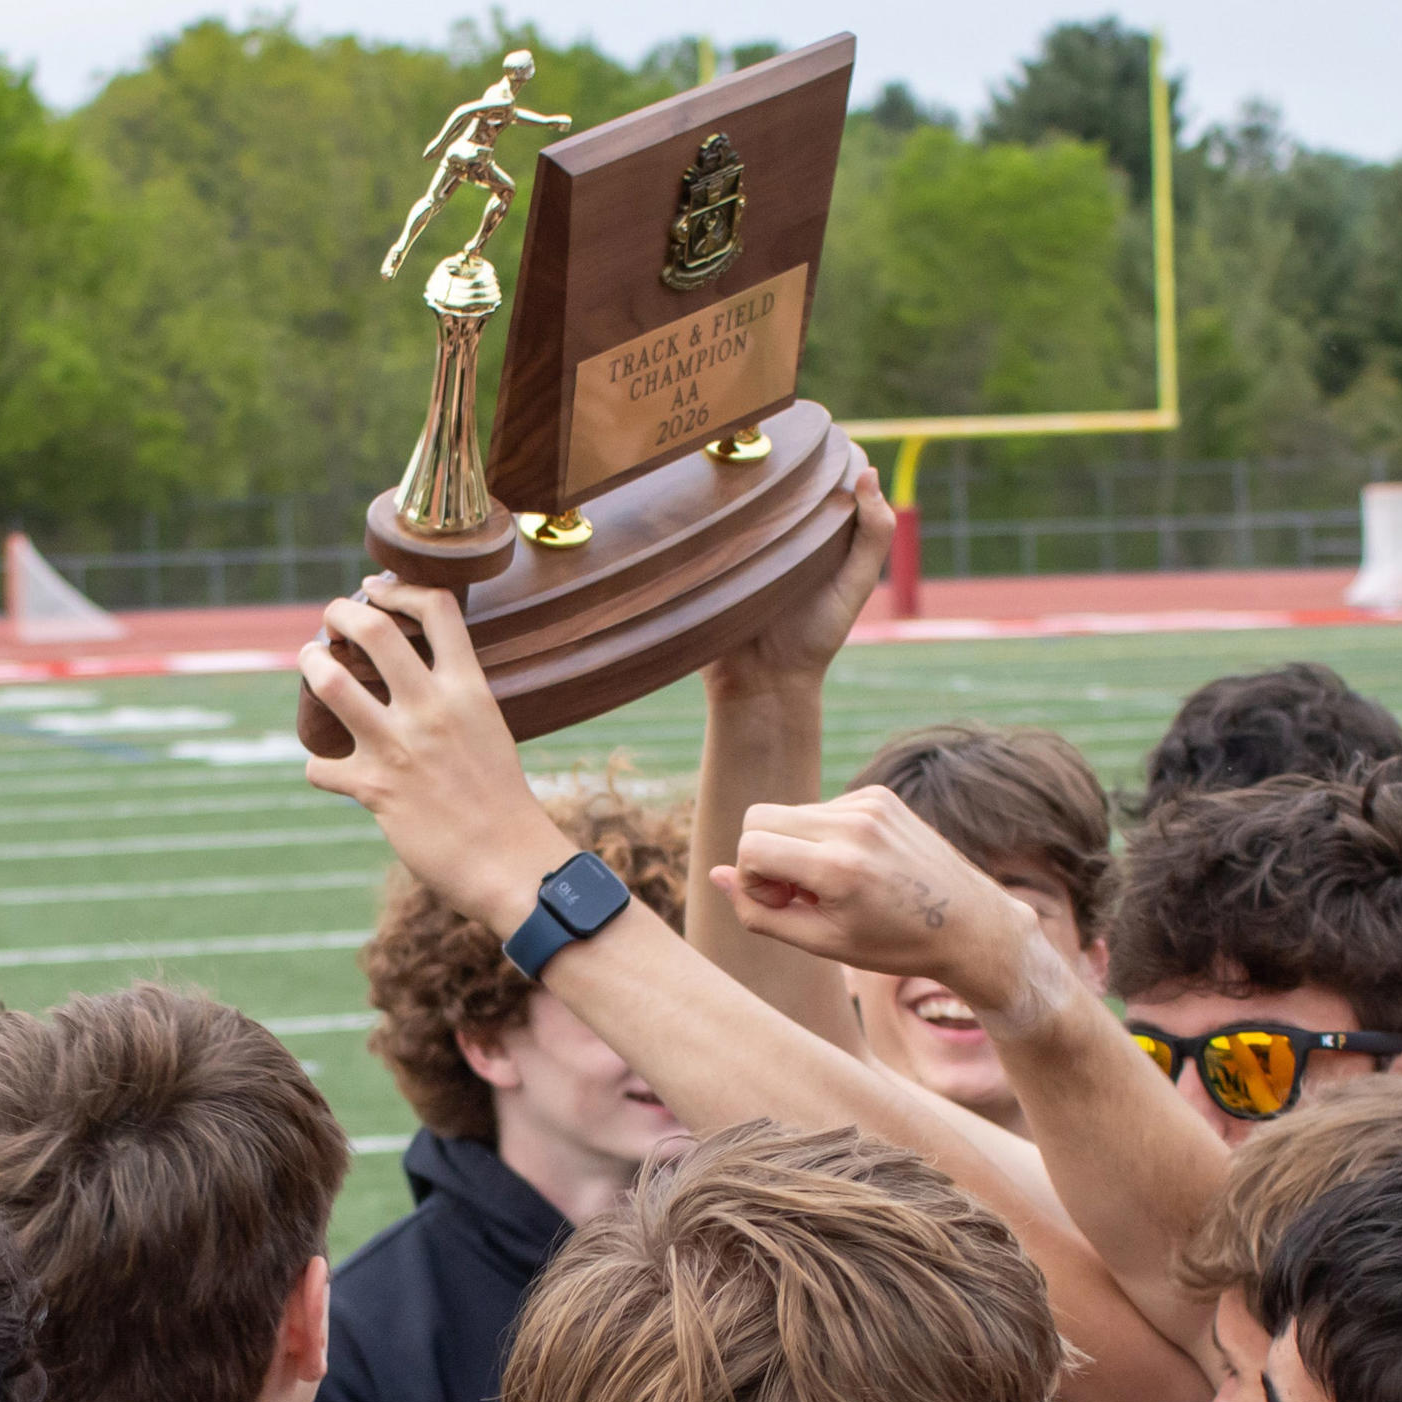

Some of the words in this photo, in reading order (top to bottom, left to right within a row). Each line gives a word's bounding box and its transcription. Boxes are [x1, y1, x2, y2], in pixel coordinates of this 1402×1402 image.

[608, 333, 679, 383] TRACK
[689, 323, 701, 347] &
[713, 291, 776, 337] FIELD
[629, 332, 748, 401] CHAMPION
[670, 379, 700, 412] AA
[654, 402, 710, 446] 2026
